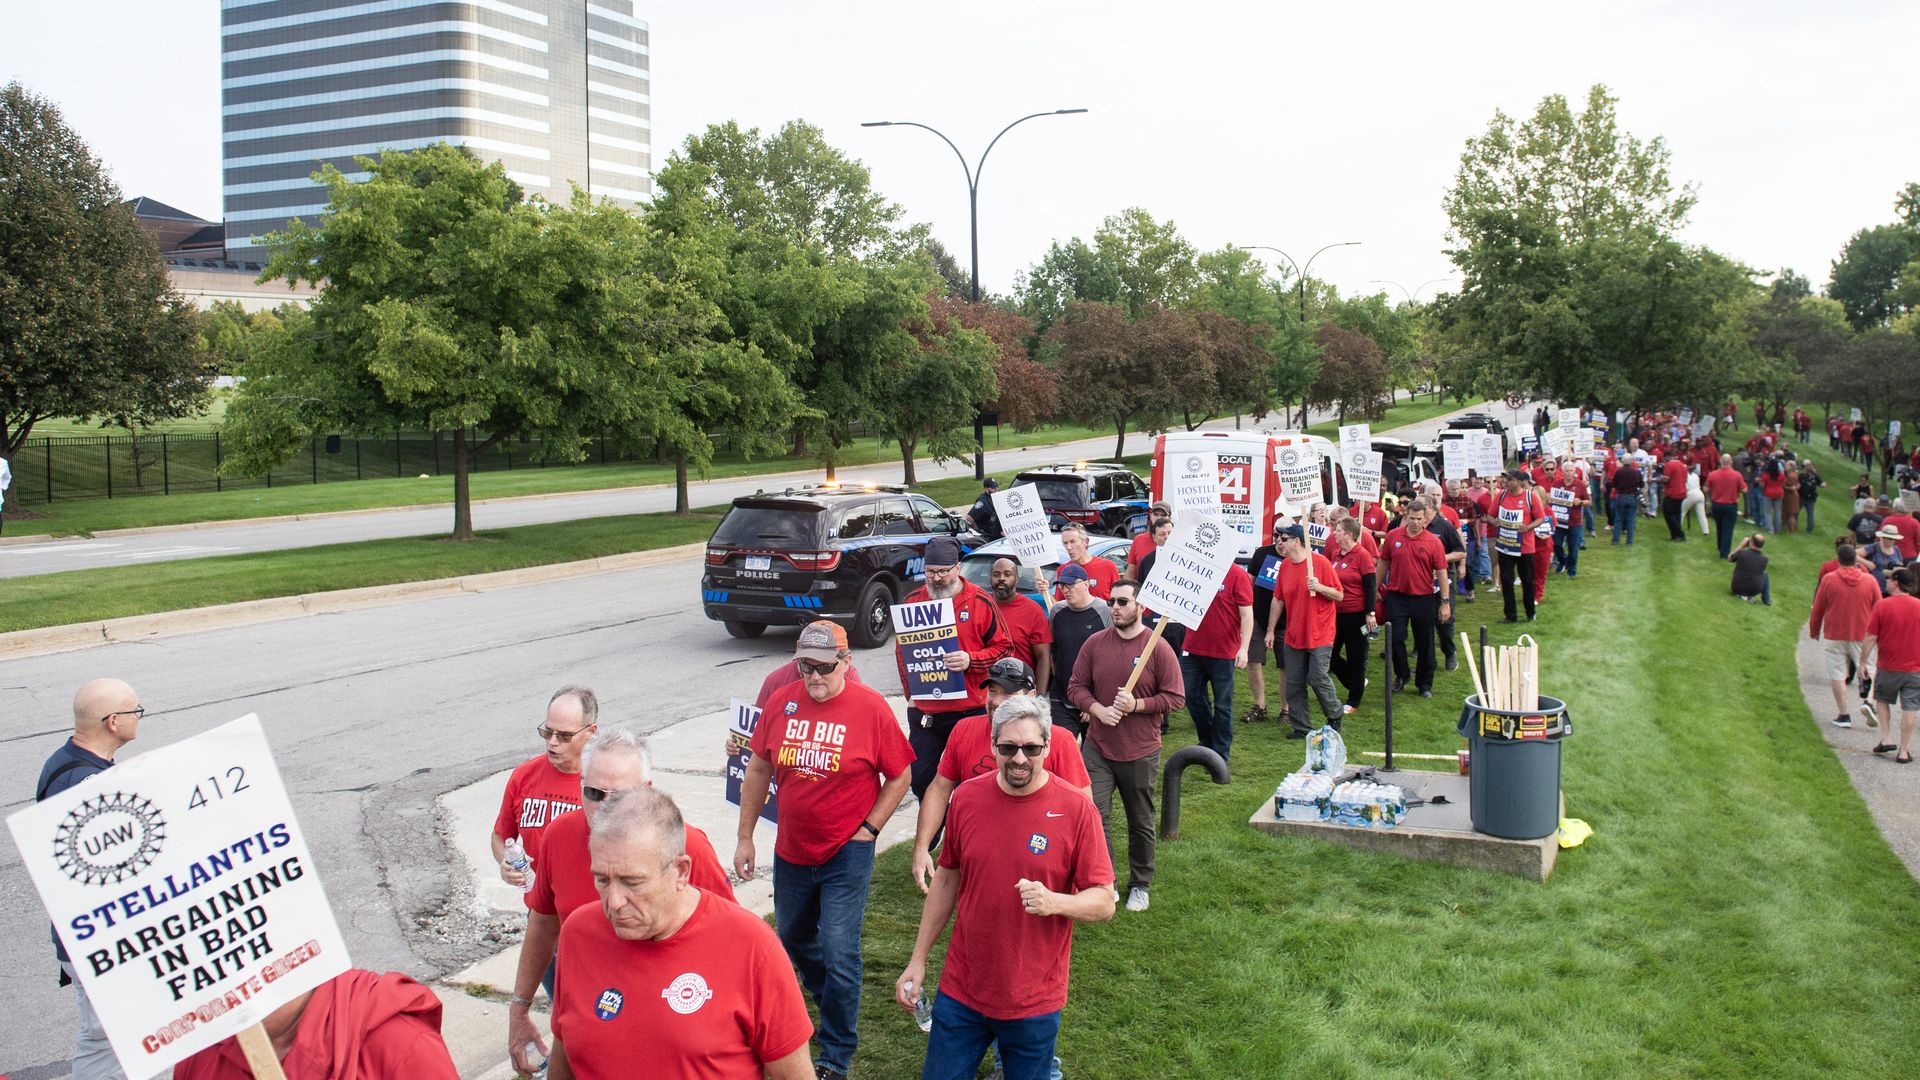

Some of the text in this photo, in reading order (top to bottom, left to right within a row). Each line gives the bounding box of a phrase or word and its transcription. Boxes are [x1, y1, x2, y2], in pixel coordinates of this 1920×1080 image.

[1280, 465, 1318, 476] STELLANTIS
[1281, 473, 1319, 483] BARGAINING
[1350, 467, 1380, 476] STELLANTIS
[1177, 484, 1217, 496] HOSTILE
[1292, 487, 1311, 495] FAITH
[1299, 480, 1312, 488] BAD
[1183, 497, 1213, 506] WORK
[1005, 507, 1034, 519] LOCAL 412
[1501, 510, 1519, 521] UAW
[1004, 519, 1047, 536] BARGAINING
[1309, 524, 1325, 538] AW
[1012, 531, 1045, 546] IN BAD
[1018, 545, 1046, 558] FAITH
[1184, 542, 1215, 560] LOCAL 412
[904, 557, 926, 576] POL
[1170, 552, 1214, 580] UNFAIR
[736, 570, 781, 580] POLICE
[1164, 570, 1202, 595] LABOR
[1144, 581, 1206, 617] PRACTICES
[901, 603, 943, 628] UAW
[900, 629, 953, 644] STAND UP
[913, 646, 947, 659] COLA
[907, 662, 935, 673] FAIR
[920, 671, 949, 683] NOW
[739, 705, 761, 733] UA
[785, 718, 847, 746] GO BIG
[731, 734, 750, 747] STA
[778, 746, 841, 772] MAHOMES
[187, 766, 250, 810] 412
[519, 797, 548, 828] RED
[84, 821, 135, 856] UAW
[70, 823, 292, 941] STELLANTIS
[86, 856, 304, 977] BARGAINING
[149, 905, 269, 979] IN BAD
[166, 932, 273, 1001] FAITH
[142, 939, 322, 1054] CORPORATE GREED
[602, 990, 623, 1004] 97%
